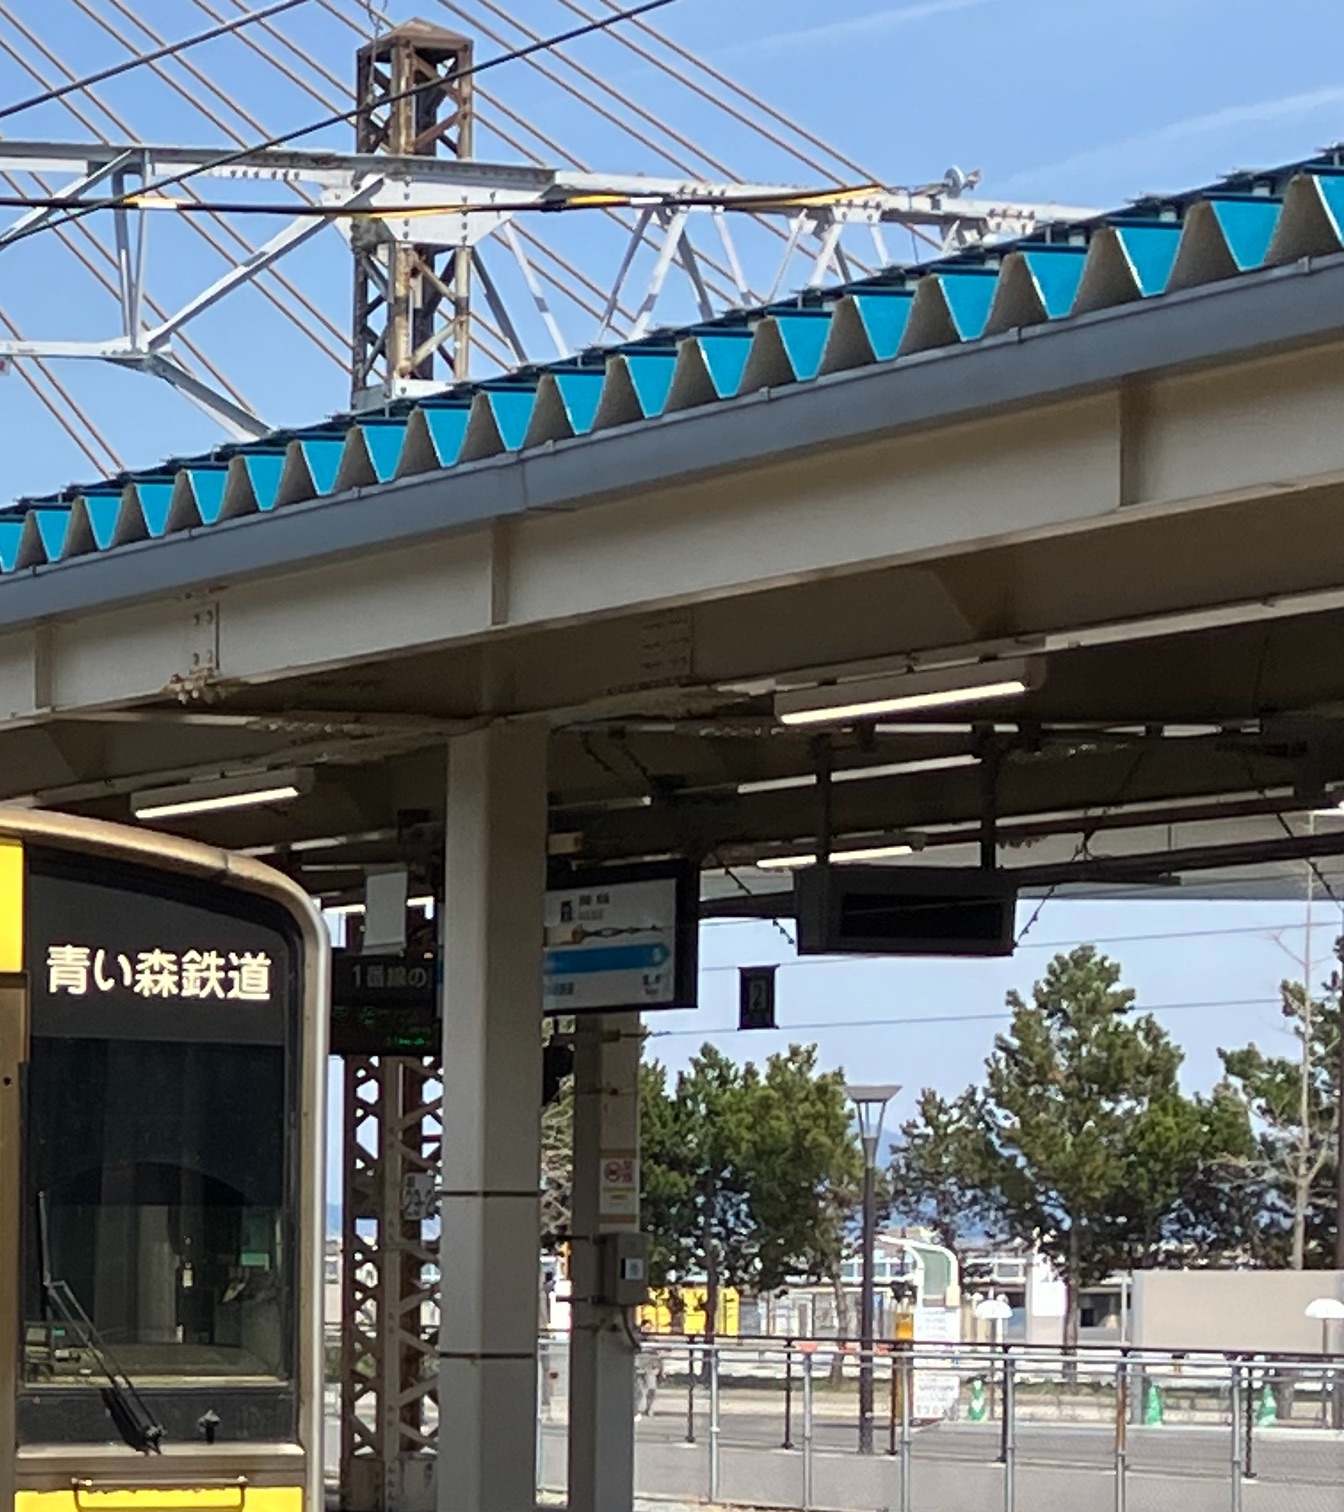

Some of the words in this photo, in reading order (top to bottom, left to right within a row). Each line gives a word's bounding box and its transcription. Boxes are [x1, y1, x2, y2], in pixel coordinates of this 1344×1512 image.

[46, 944, 273, 1001] 青い森鉄道
